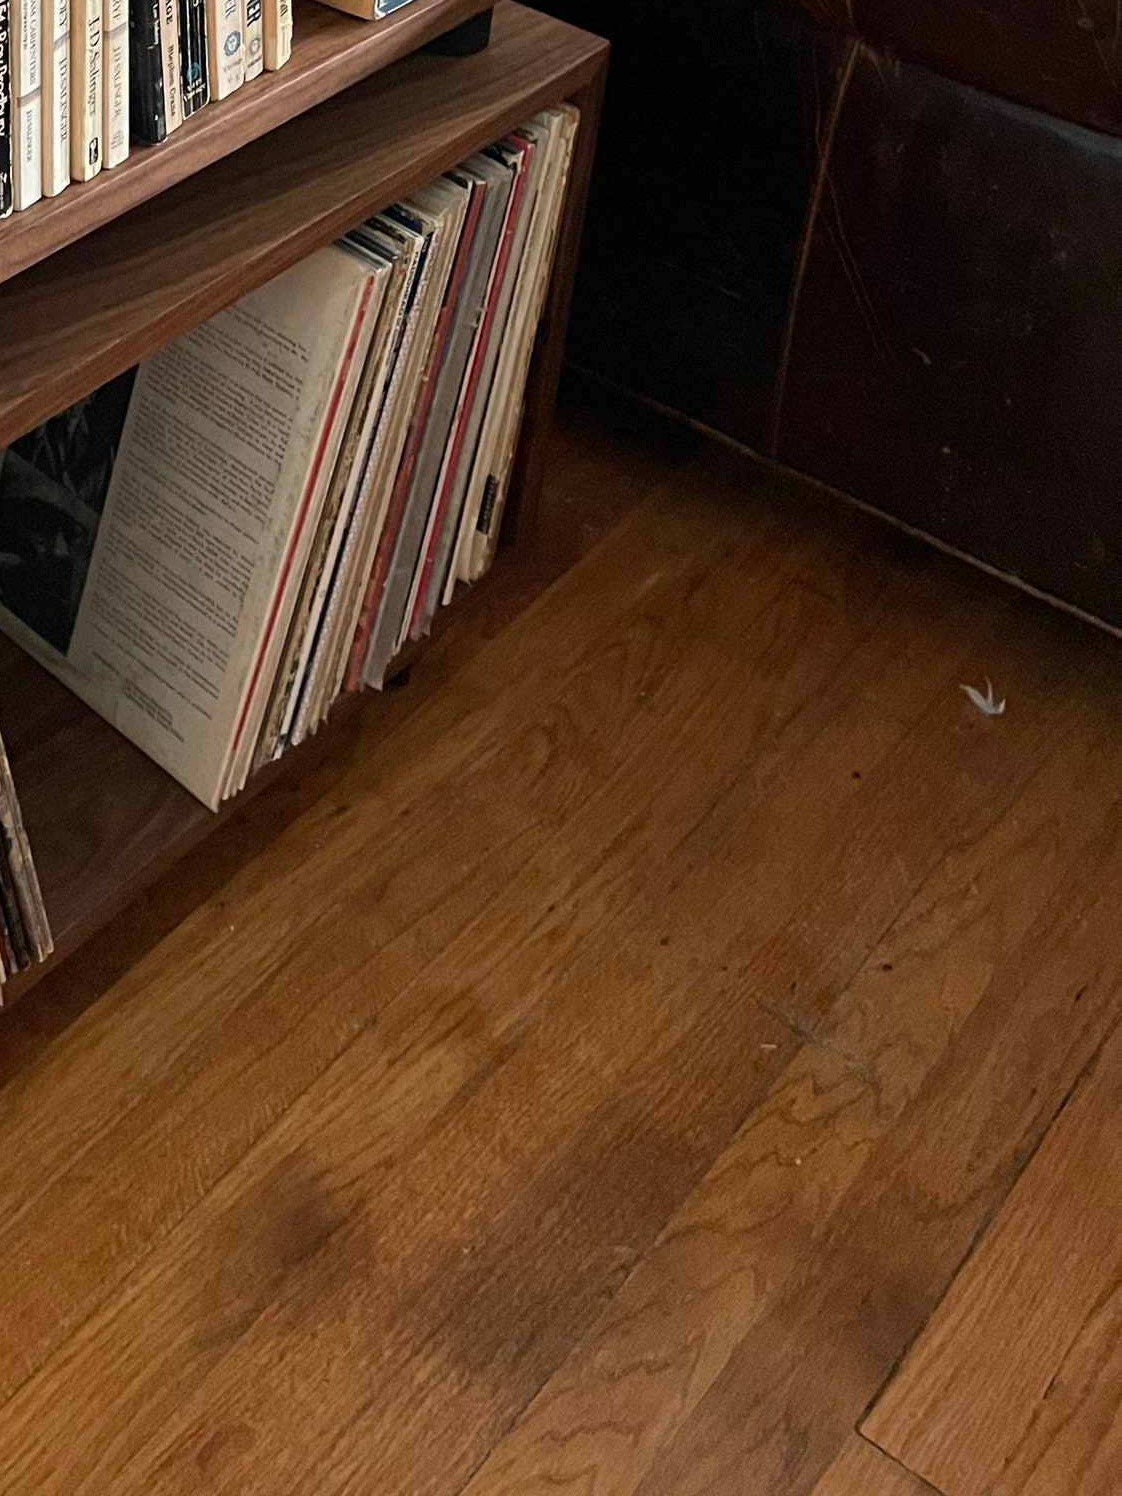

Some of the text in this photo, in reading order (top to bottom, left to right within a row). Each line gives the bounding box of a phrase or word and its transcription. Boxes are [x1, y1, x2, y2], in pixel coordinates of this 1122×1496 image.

[87, 49, 100, 116] Salinger
[167, 44, 176, 88] Stephen
[169, 87, 177, 118] Crane
